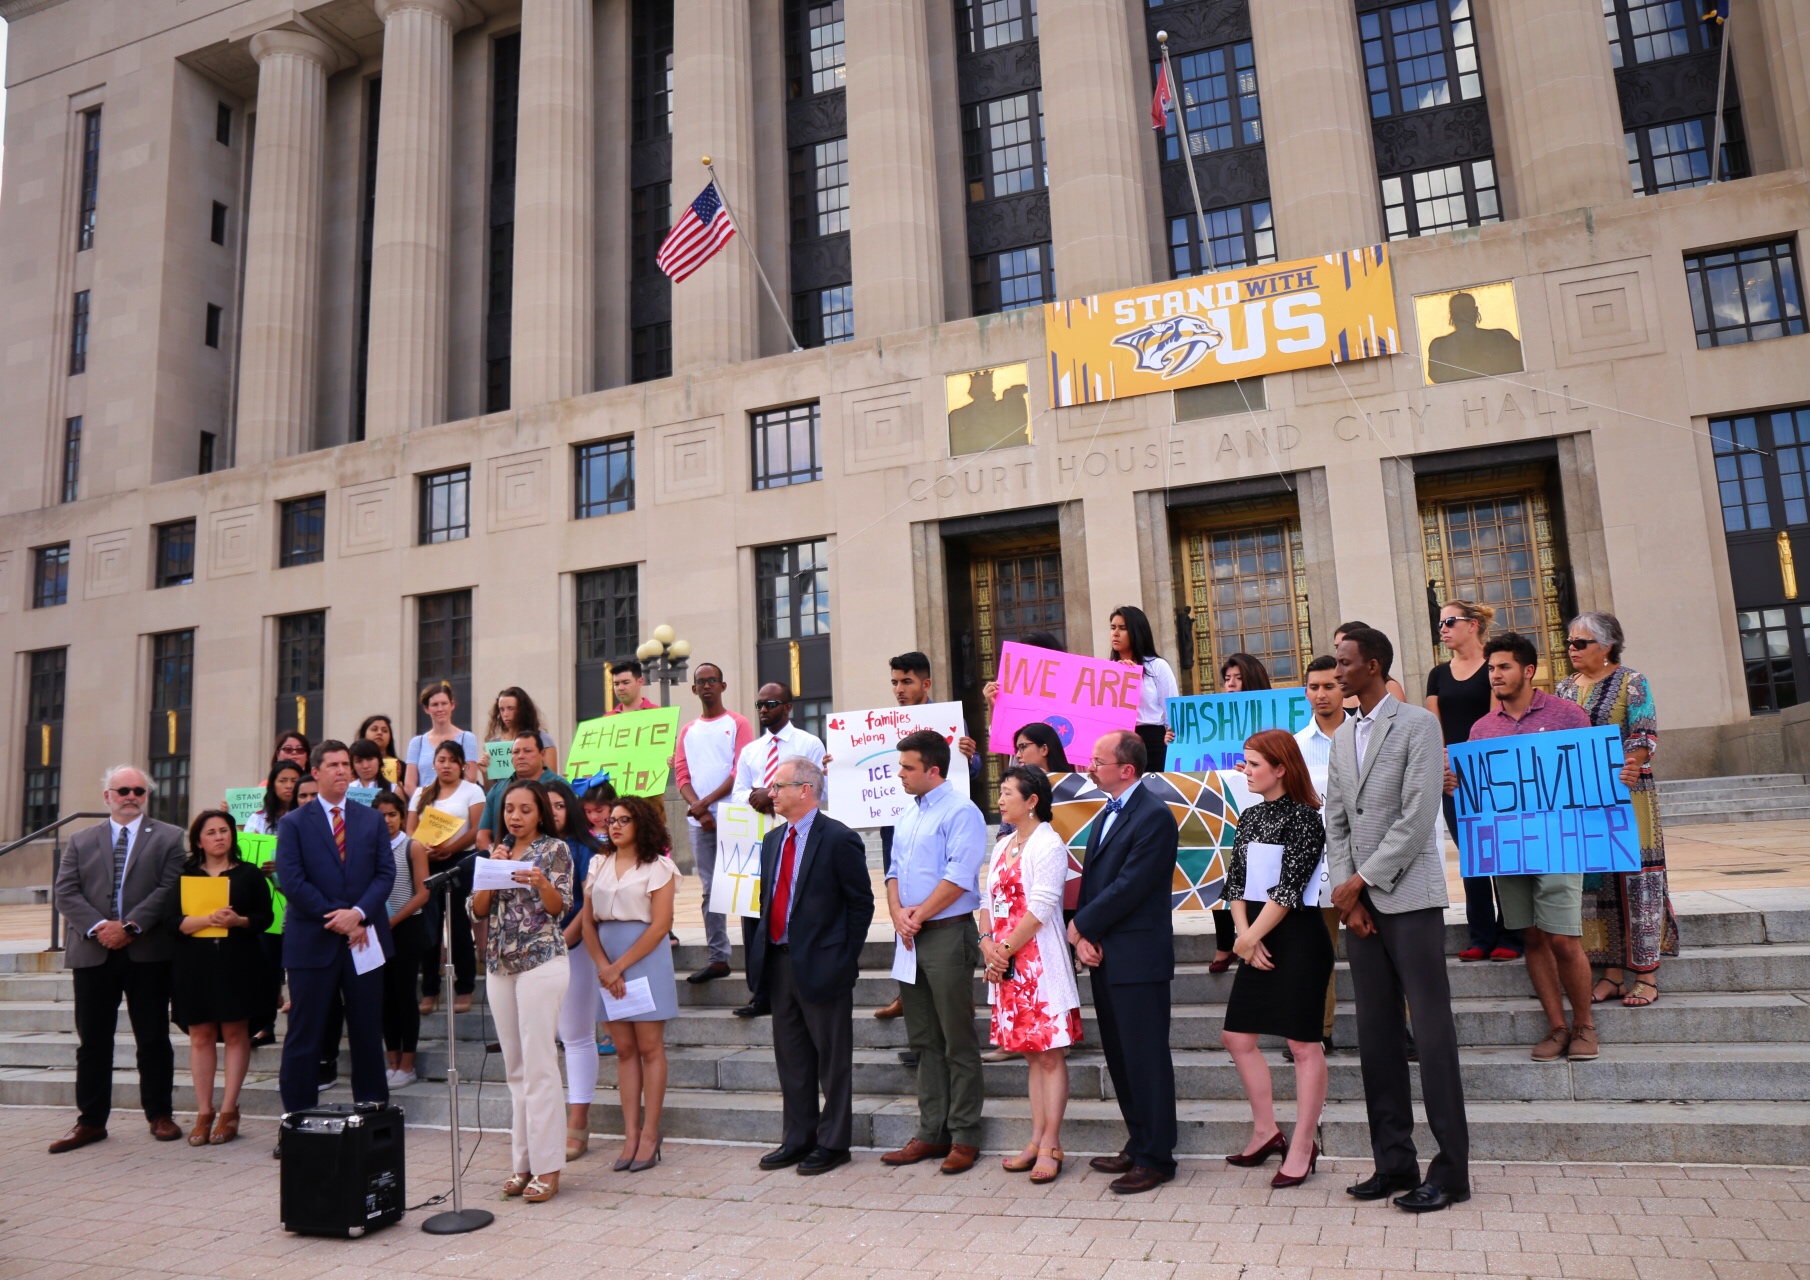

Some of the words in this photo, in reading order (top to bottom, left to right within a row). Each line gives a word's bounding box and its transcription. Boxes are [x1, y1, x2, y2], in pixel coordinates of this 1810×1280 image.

[1114, 280, 1240, 325] STAND
[1245, 270, 1314, 298] WITH
[1207, 291, 1327, 365] US
[907, 461, 1033, 502] COURT
[1057, 440, 1185, 485] HOUSE
[1215, 423, 1301, 462] AND
[1333, 403, 1431, 443] CITY
[1462, 384, 1589, 429] HALL
[1003, 652, 1061, 699] WE
[1071, 666, 1143, 711] ARE
[865, 710, 912, 731] families
[578, 722, 670, 750] #Here
[850, 732, 886, 748] belong
[489, 748, 504, 756] WE
[868, 764, 892, 782] ICE
[1453, 735, 1631, 816] NASHVILLE
[231, 802, 253, 810] WITH
[869, 806, 882, 819] be
[1458, 806, 1637, 877] TOGETHER
